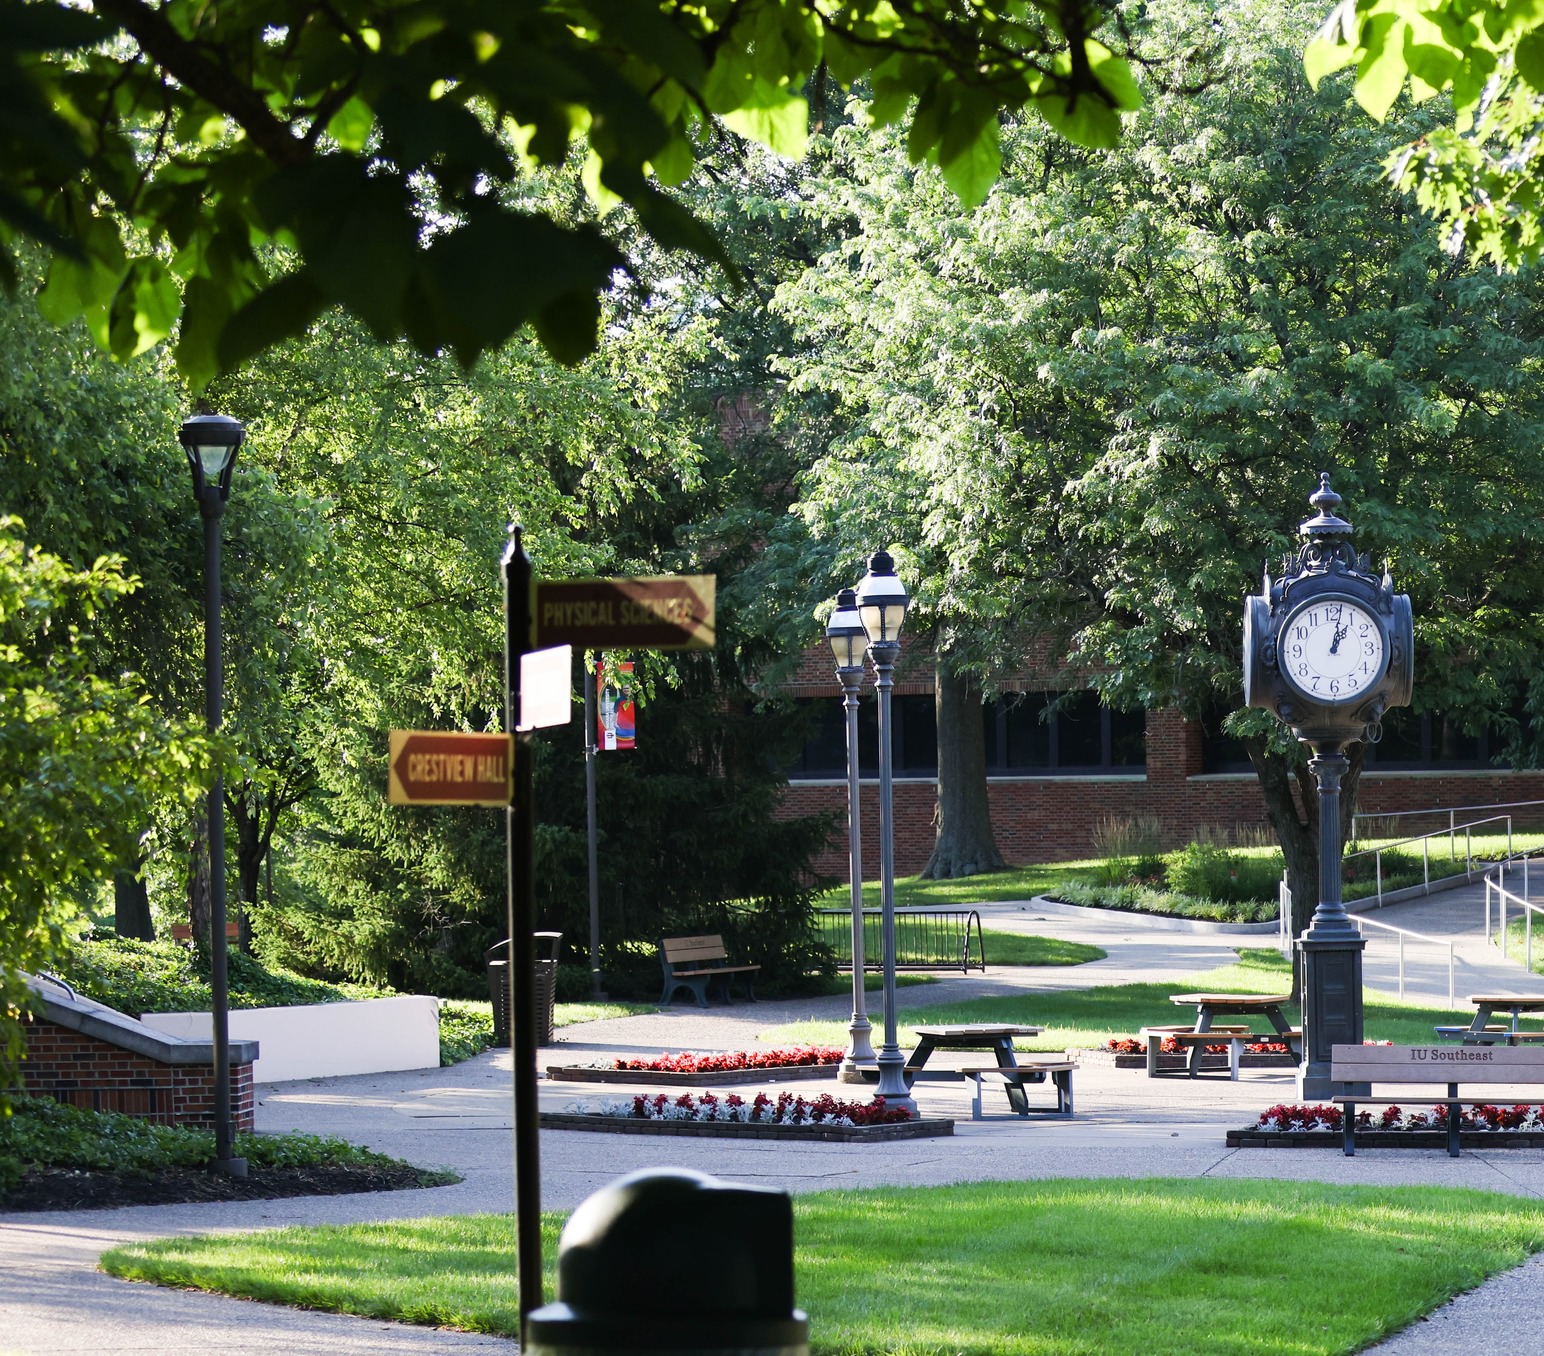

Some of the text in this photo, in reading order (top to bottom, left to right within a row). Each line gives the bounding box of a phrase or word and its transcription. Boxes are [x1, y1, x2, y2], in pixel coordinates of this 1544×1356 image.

[543, 598, 693, 627] PHYSICAL SCIENCES
[1309, 612, 1318, 627] 11
[1325, 607, 1339, 621] 12
[1349, 612, 1354, 626] 1
[1296, 626, 1308, 640] 10
[1359, 624, 1369, 638] 2
[1292, 644, 1302, 659] 9
[1364, 641, 1374, 656] 3
[1299, 663, 1308, 677] 8
[1359, 662, 1369, 675] 4
[1311, 676, 1321, 691] 7
[1330, 679, 1340, 694] 6
[1348, 674, 1357, 688] 5
[408, 753, 506, 784] CRESTVIEW HALL
[1411, 1049, 1493, 1061] IU Southeast
